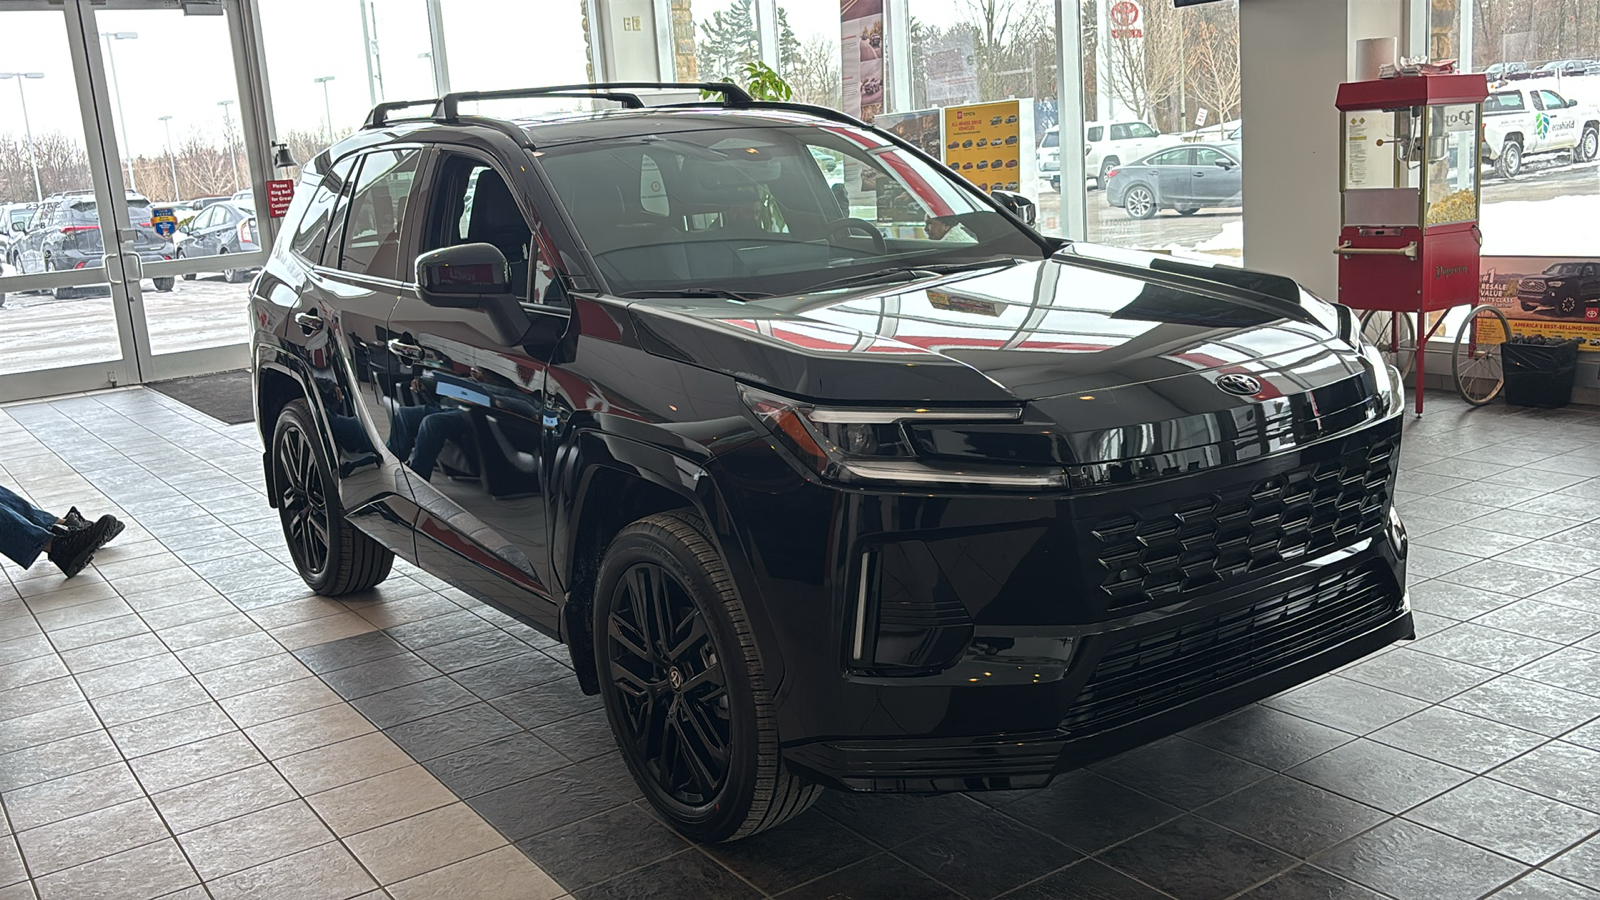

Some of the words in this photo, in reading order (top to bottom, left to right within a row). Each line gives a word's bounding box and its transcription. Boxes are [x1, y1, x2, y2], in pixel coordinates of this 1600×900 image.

[1552, 120, 1574, 131] ecoshield
[1435, 266, 1467, 279] Popcorn
[1482, 267, 1497, 283] #1
[1481, 283, 1507, 291] RESALE
[1543, 323, 1582, 331] BEST-SELLING
